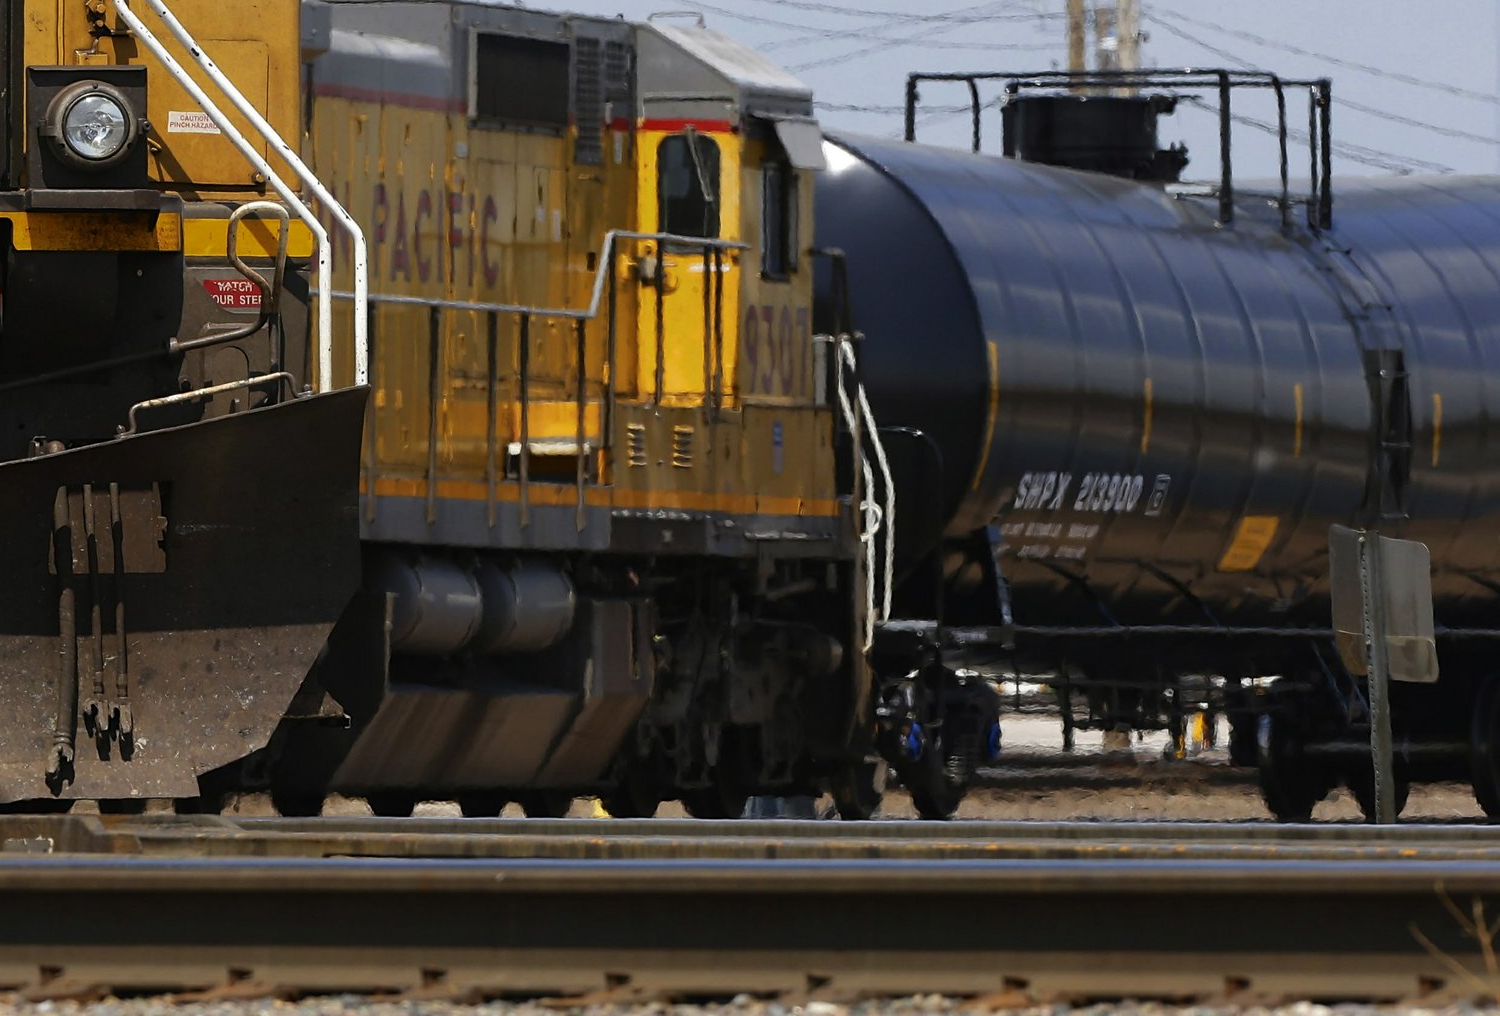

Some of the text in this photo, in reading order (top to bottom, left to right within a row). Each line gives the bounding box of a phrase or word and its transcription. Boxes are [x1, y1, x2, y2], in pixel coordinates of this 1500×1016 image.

[372, 184, 500, 288] PACIFIC
[211, 294, 234, 305] OUR
[1013, 471, 1072, 510] SHPX
